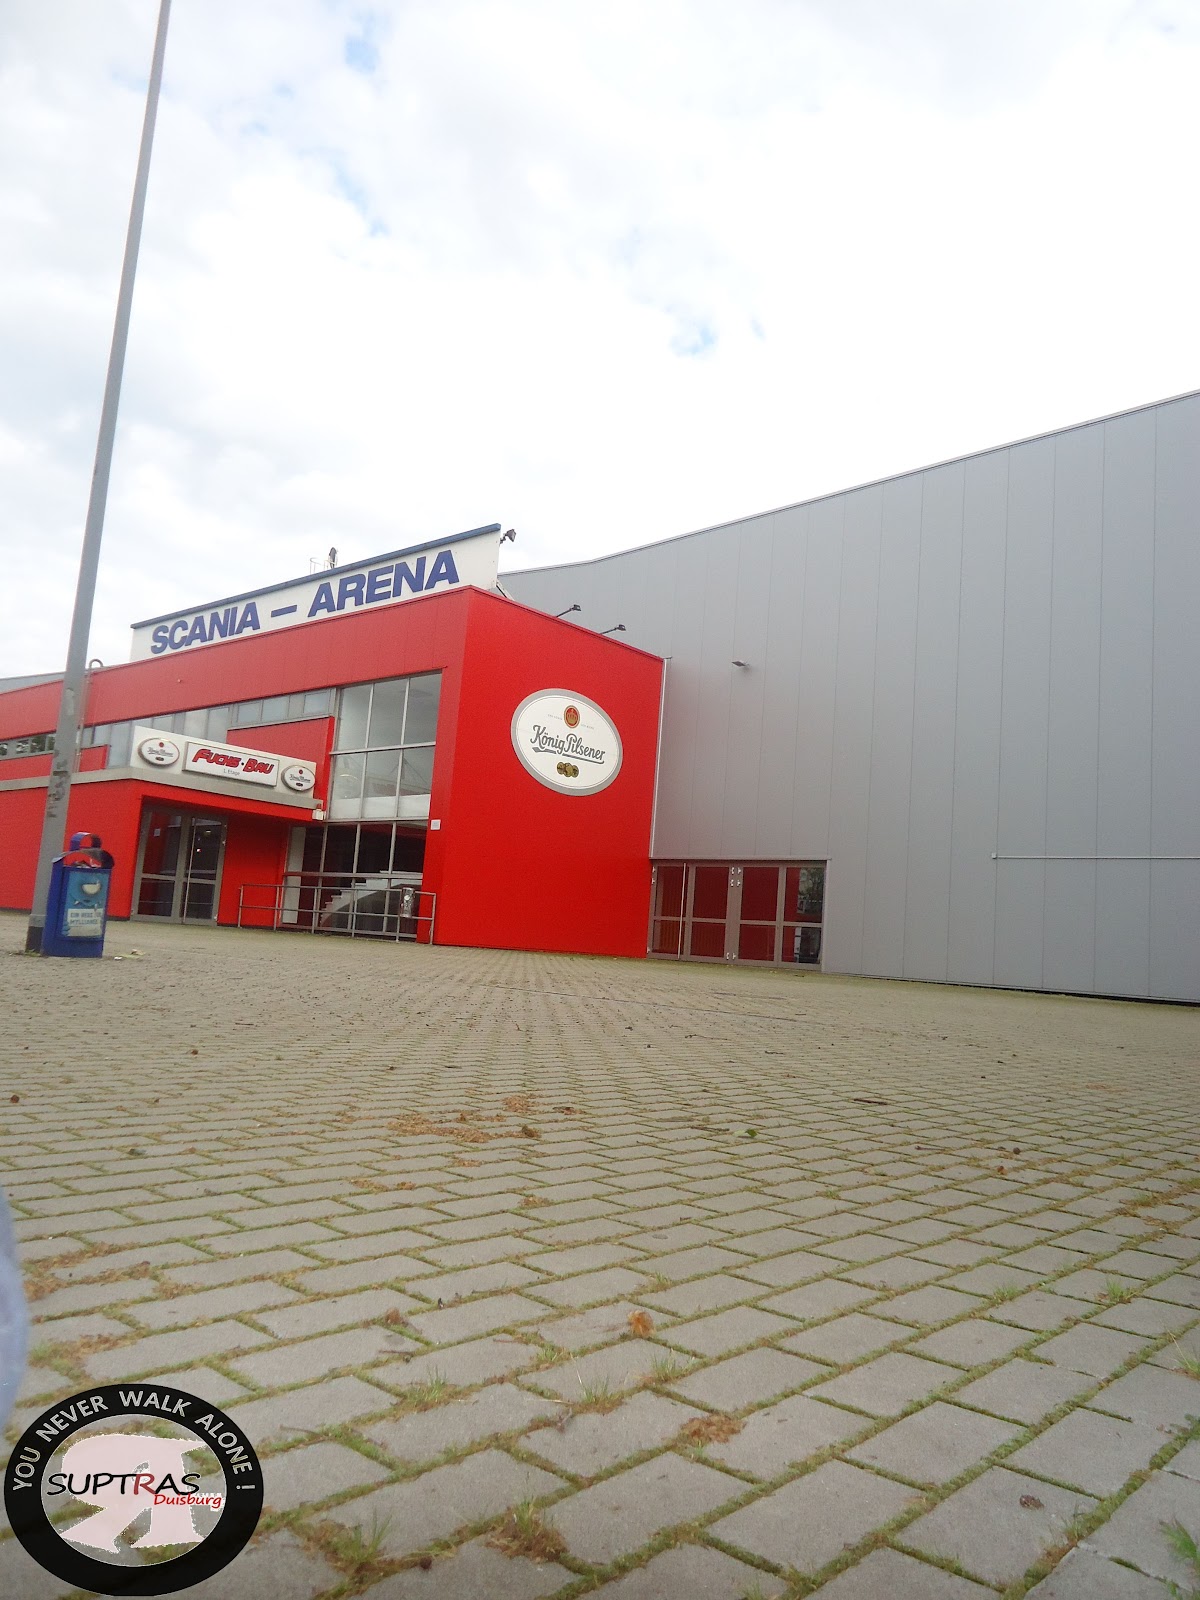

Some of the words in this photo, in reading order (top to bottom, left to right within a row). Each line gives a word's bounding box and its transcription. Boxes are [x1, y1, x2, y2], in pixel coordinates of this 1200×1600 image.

[150, 601, 261, 654] SCANIA
[307, 549, 460, 618] ARENA
[530, 724, 565, 754] König
[564, 733, 606, 761] Pilsener
